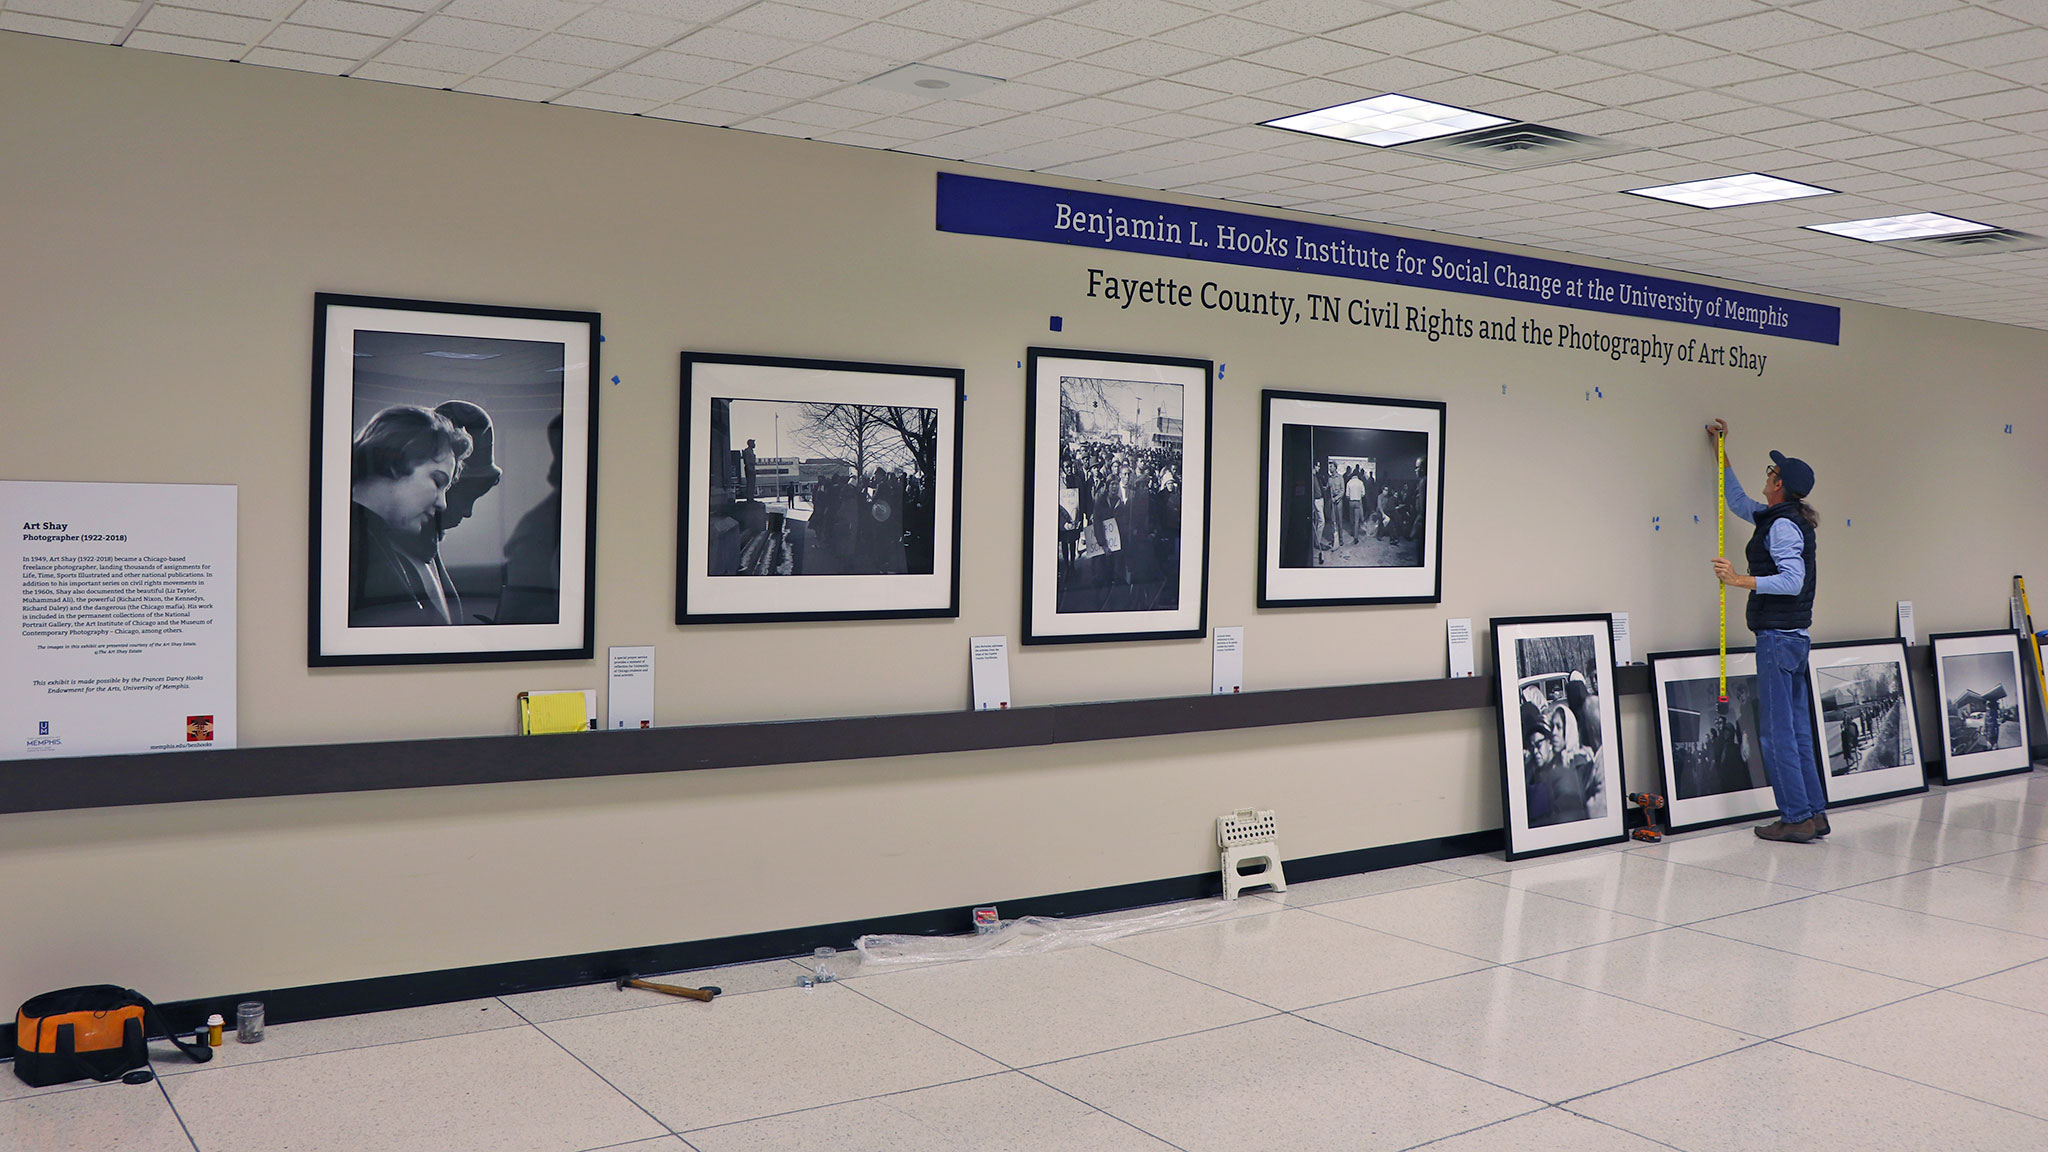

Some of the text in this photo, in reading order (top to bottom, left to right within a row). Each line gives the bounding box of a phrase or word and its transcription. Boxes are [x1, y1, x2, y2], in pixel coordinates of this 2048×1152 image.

[1055, 204, 1788, 329] Benjamin L. Hooks Institute for Social Change at the University of Memphis
[1087, 269, 1767, 376] Fayette County, TN Civil Rights and the Photography of Art Shay
[43, 522, 68, 531] Shay
